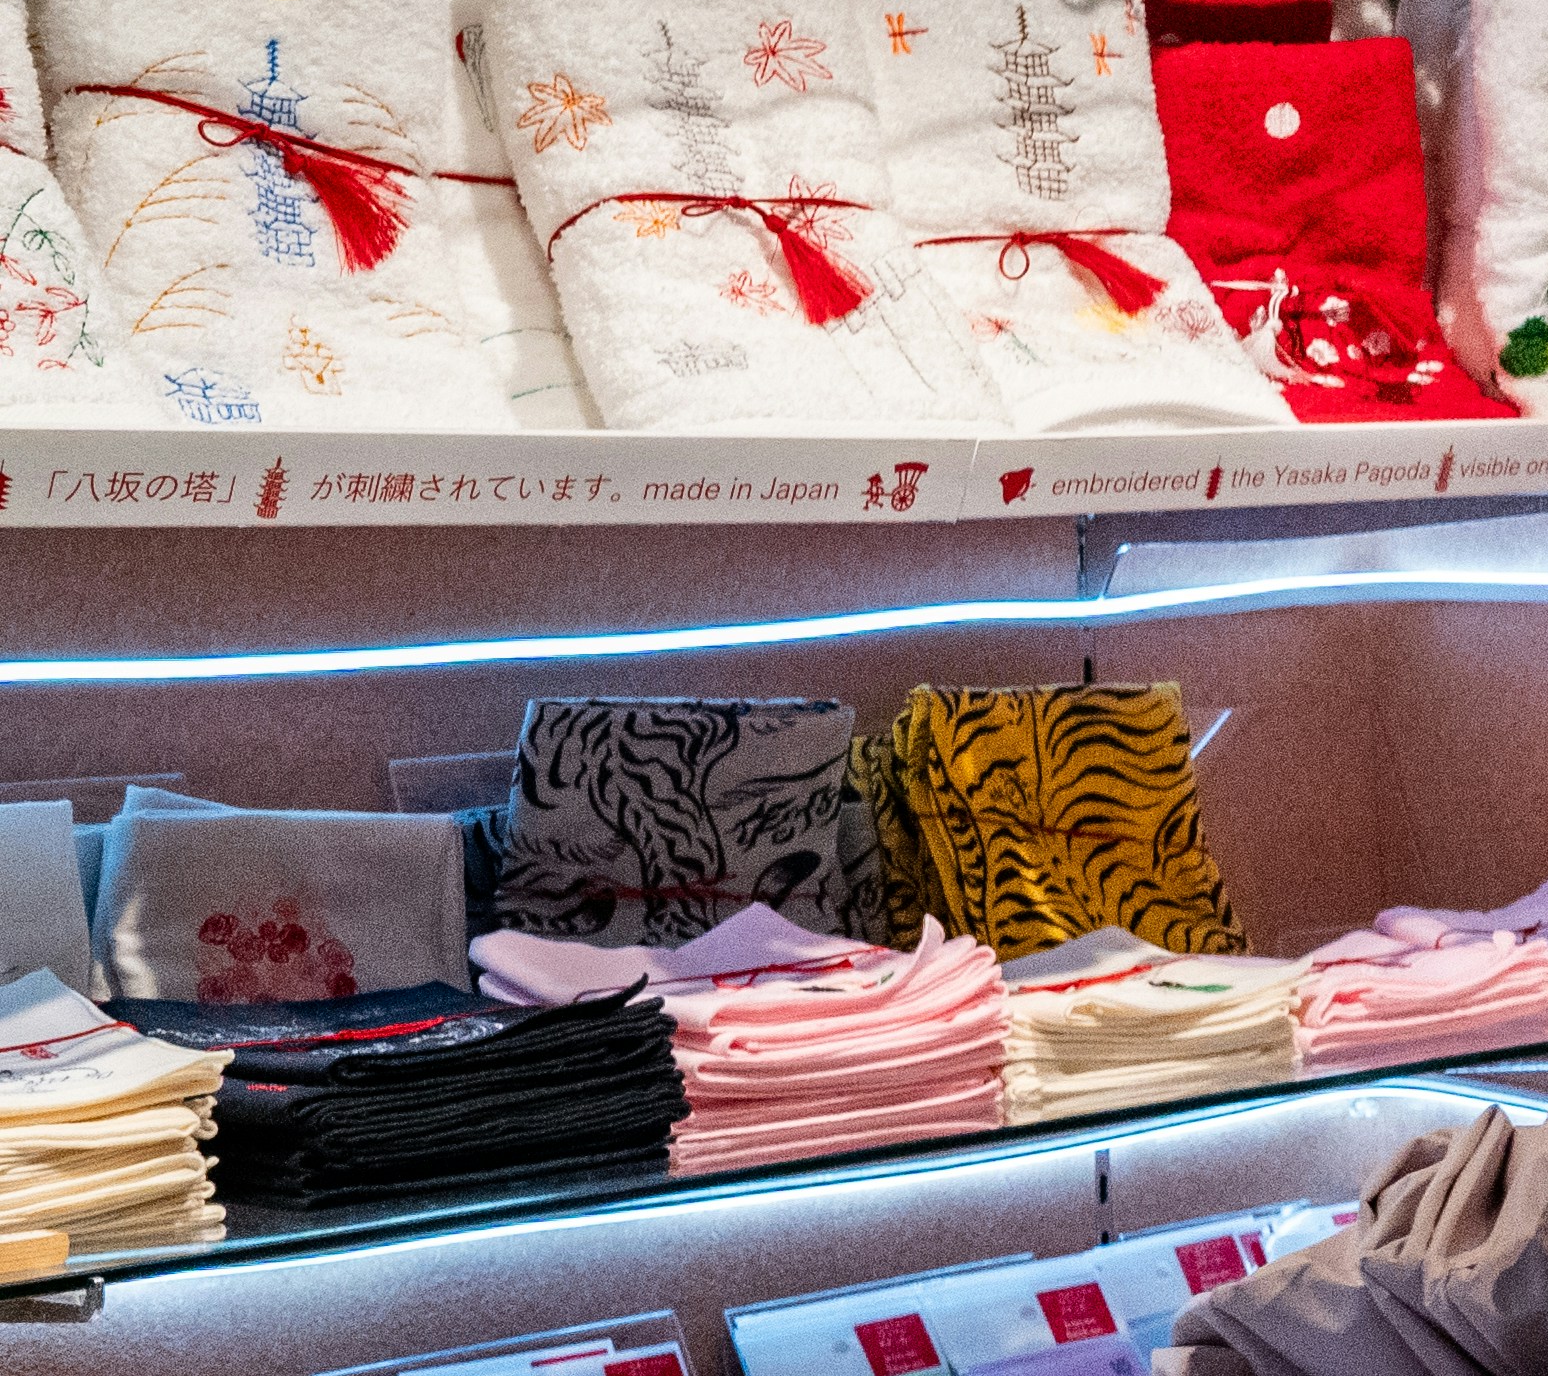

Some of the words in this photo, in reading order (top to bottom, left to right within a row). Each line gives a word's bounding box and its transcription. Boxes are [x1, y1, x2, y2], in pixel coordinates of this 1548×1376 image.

[47, 470, 238, 504] 「八坂の塔」
[310, 471, 623, 504] が刺繍されています。
[643, 477, 720, 502] made
[729, 477, 751, 501] in
[760, 478, 840, 505] Japan
[1052, 470, 1200, 497] embroidered
[1231, 466, 1264, 490] the
[1275, 463, 1347, 488] Yasaka
[1354, 460, 1431, 487] Pagoda
[1460, 453, 1520, 479] visible
